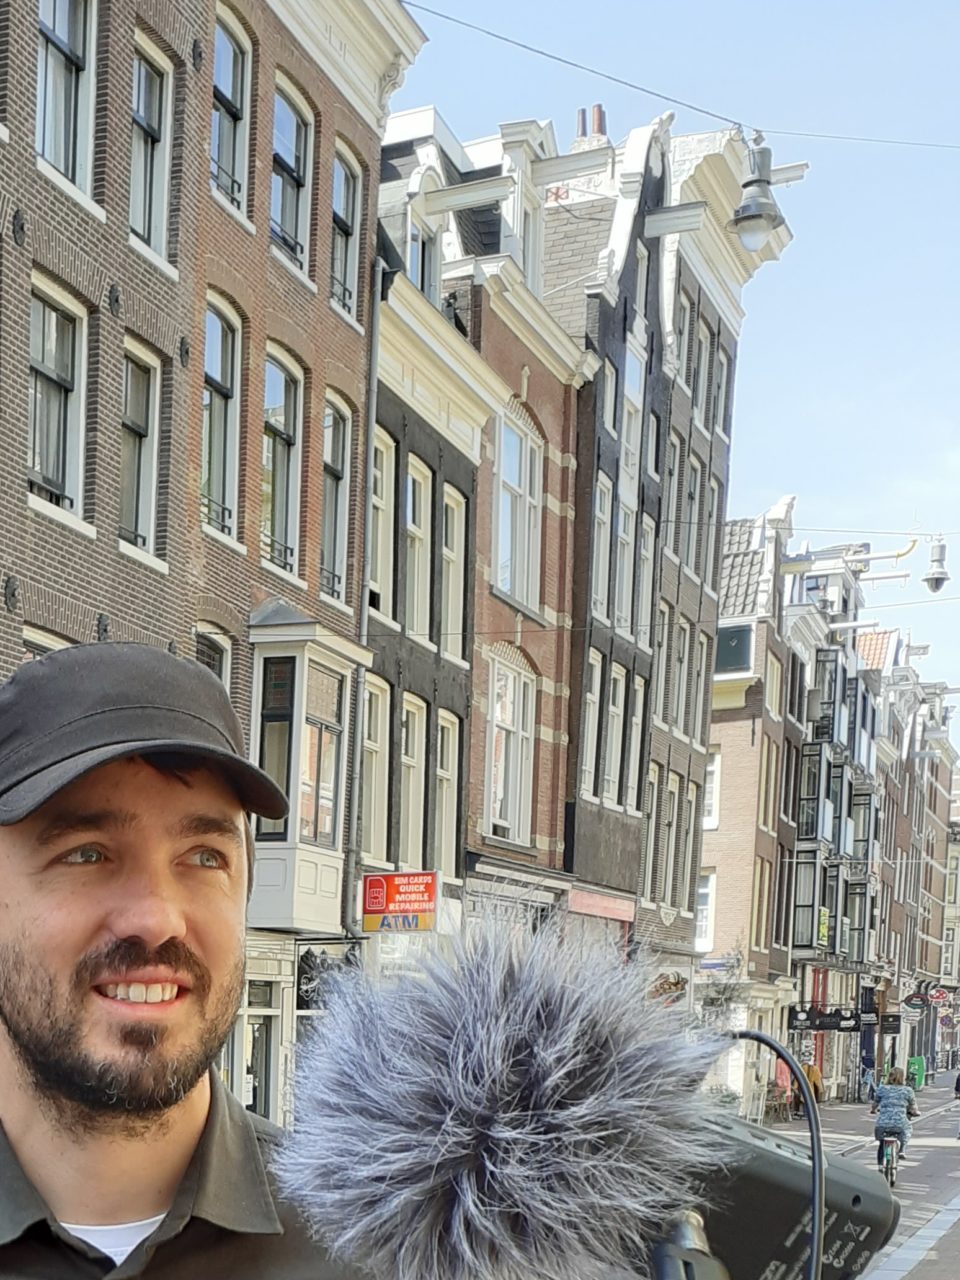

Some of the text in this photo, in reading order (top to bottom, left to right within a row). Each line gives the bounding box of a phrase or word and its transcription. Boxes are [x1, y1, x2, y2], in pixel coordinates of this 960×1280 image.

[395, 893, 429, 902] MOBILE
[389, 902, 435, 911] REPAIRING
[380, 915, 419, 929] ATM
